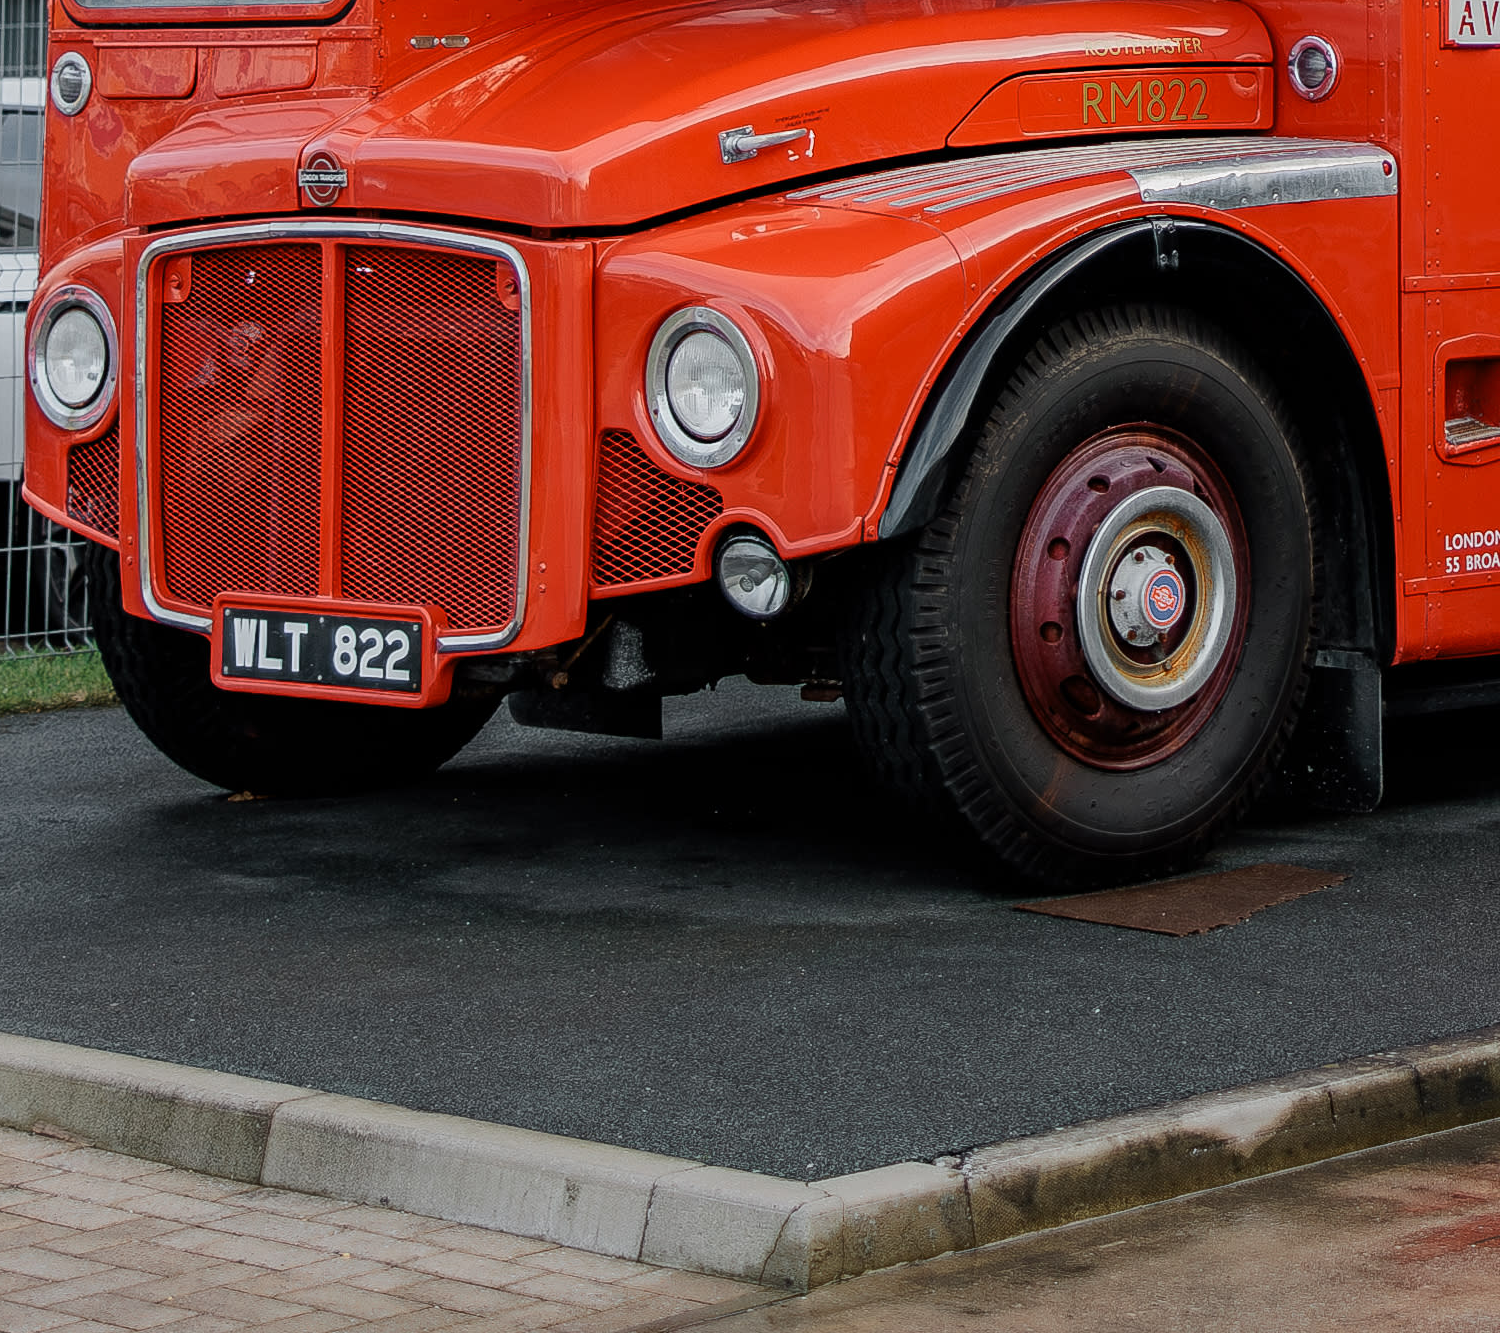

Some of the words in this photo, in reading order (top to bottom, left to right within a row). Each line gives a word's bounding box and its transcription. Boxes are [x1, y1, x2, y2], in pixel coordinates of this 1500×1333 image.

[1458, 0, 1500, 36] AV
[1083, 37, 1203, 57] ROUTEMASTER
[1082, 78, 1209, 124] RM822
[1445, 556, 1460, 574] 55
[233, 617, 309, 673] WLT
[333, 624, 411, 682] 822
